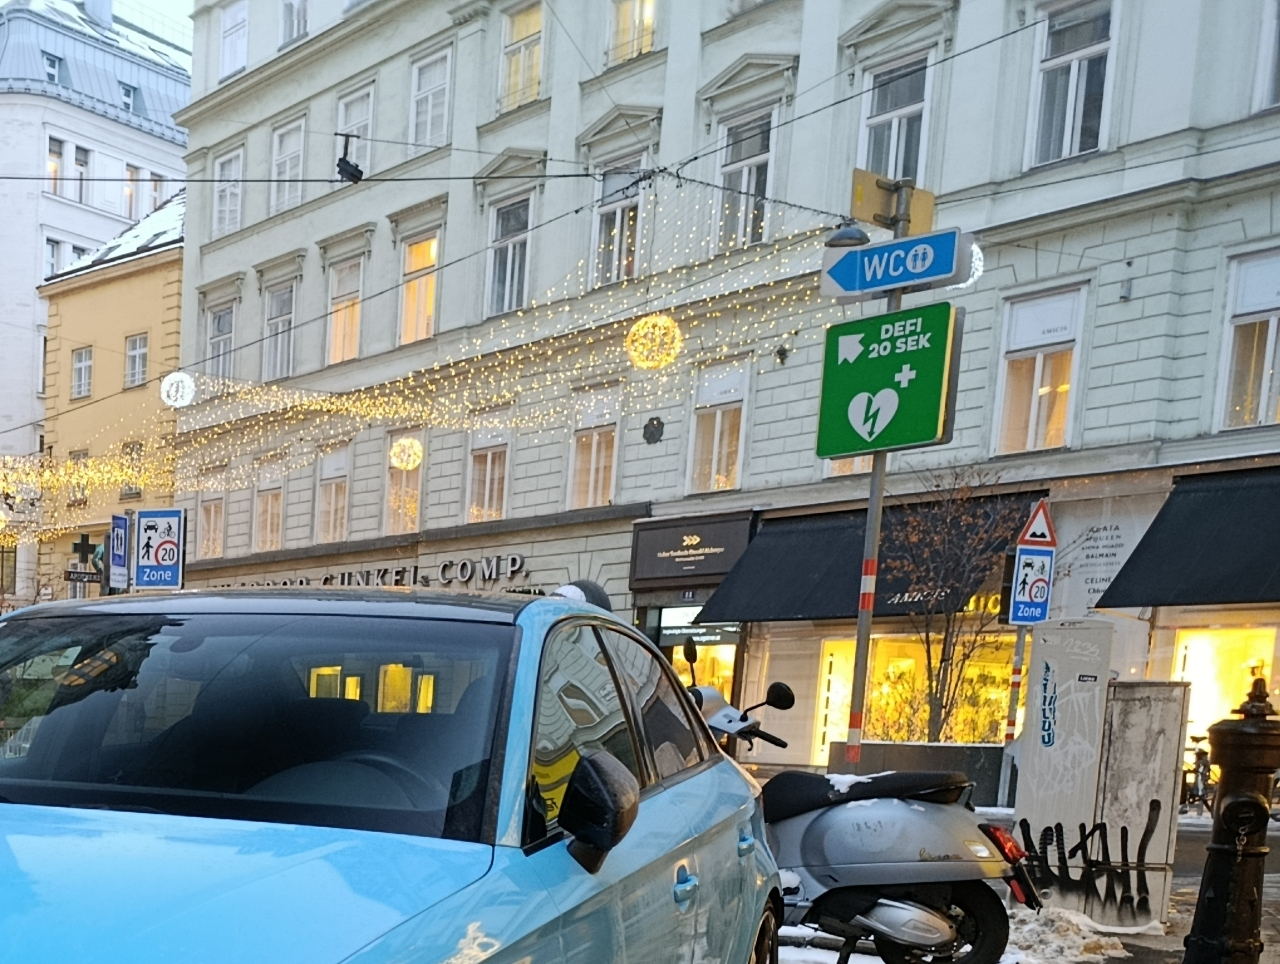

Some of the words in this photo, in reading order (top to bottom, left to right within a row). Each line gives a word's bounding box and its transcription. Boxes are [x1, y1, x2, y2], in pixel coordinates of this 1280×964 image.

[864, 250, 905, 282] WC
[880, 317, 923, 340] DEFI
[868, 342, 891, 359] 20
[895, 332, 933, 354] SEK
[161, 547, 175, 562] 20
[143, 568, 172, 581] Zone
[1033, 585, 1046, 599] 20
[1018, 604, 1042, 617] Zone
